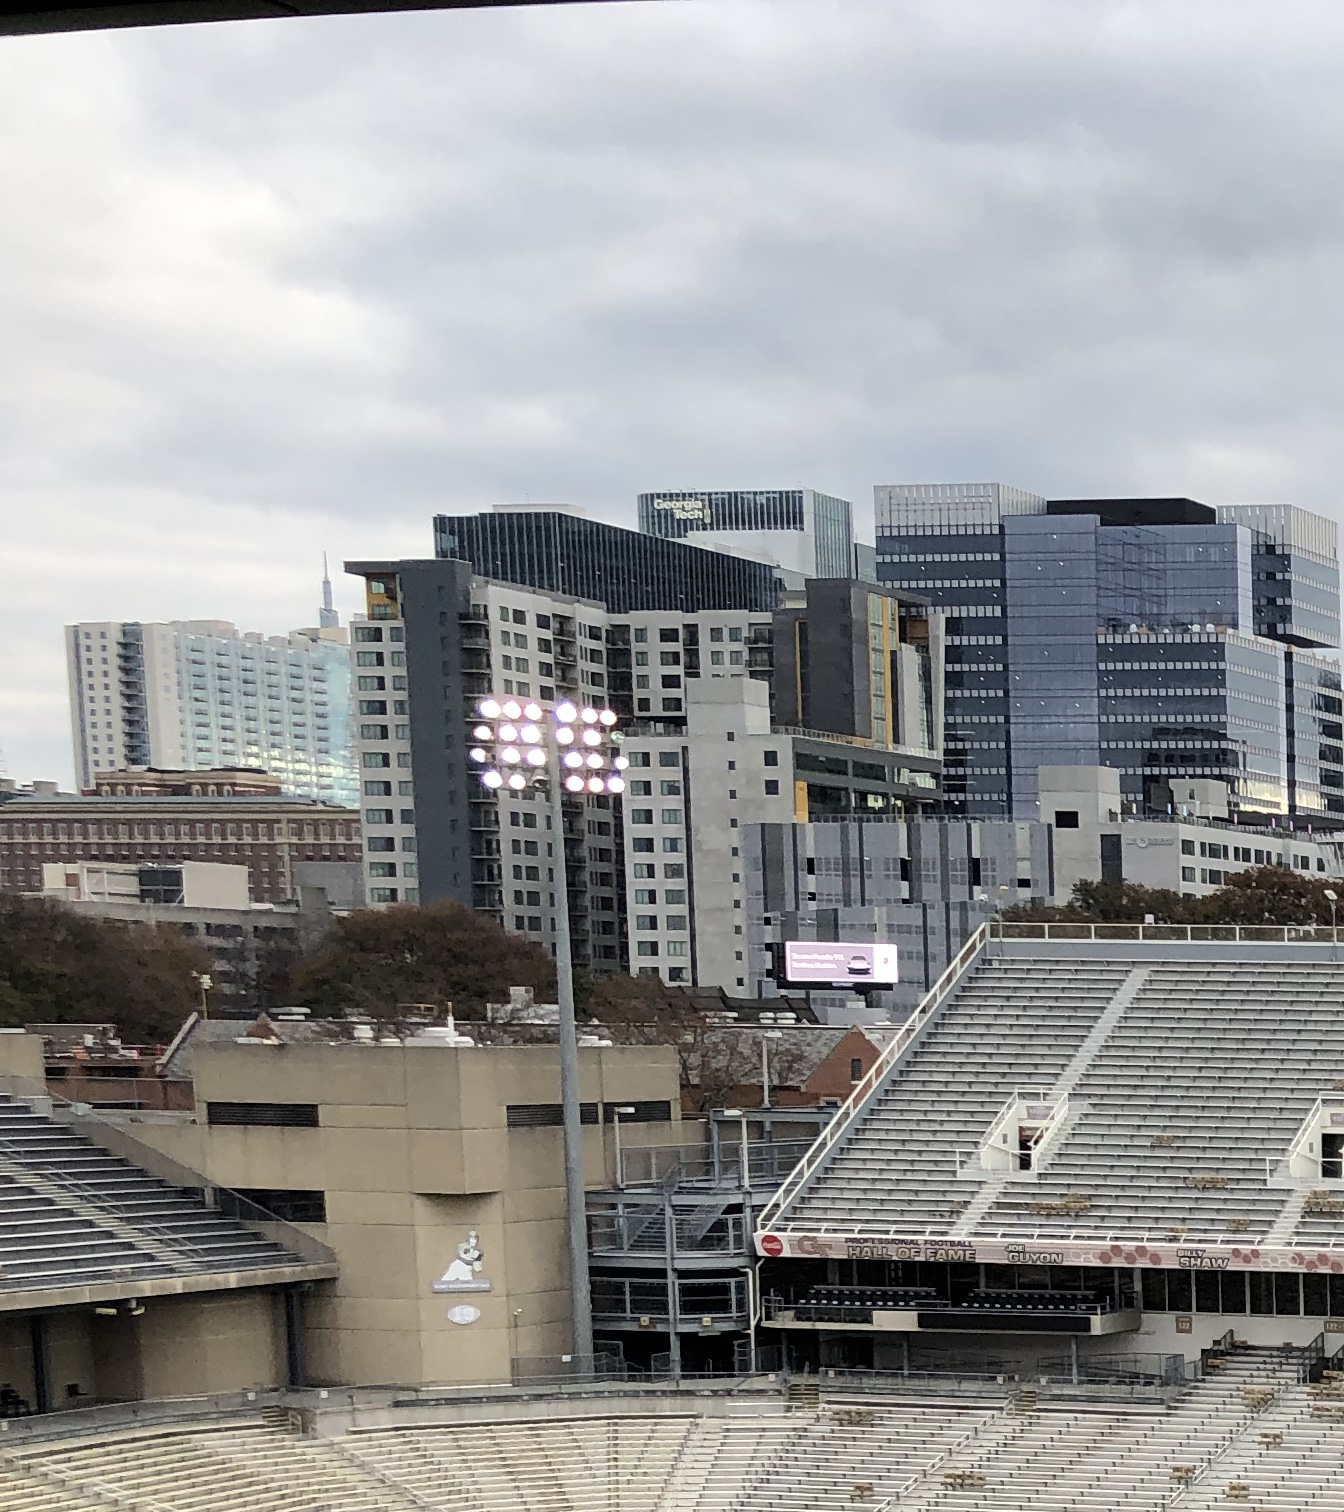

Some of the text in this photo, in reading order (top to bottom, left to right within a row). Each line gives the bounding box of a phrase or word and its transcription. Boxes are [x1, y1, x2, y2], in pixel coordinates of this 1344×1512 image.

[654, 499, 702, 511] Georgia
[672, 509, 703, 519] Tech
[846, 1238, 972, 1248] PROFESSIONAL FOOTBALL
[1005, 1244, 1024, 1252] JOE
[848, 1246, 976, 1262] HALL OF FAME
[1008, 1251, 1063, 1264] GUYON
[1177, 1249, 1205, 1257] BILLY
[1179, 1256, 1229, 1269] SHAW
